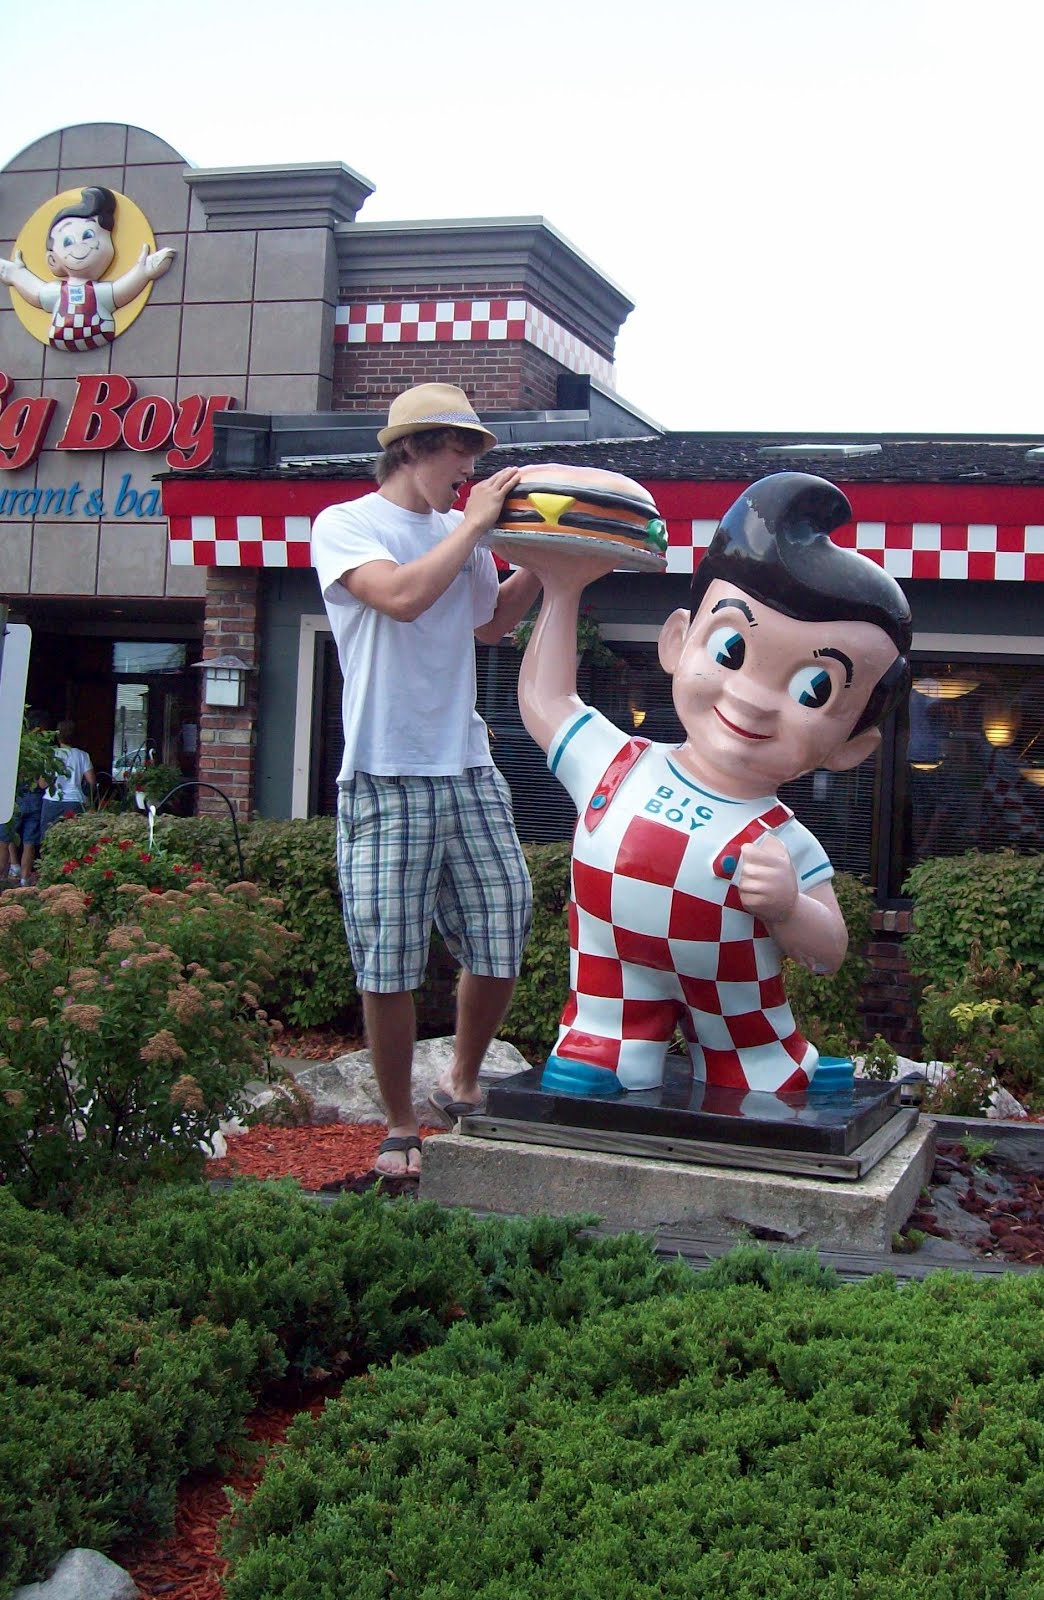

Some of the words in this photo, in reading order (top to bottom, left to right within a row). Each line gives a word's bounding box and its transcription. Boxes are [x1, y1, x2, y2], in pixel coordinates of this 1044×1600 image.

[0, 371, 57, 470] g
[56, 374, 236, 470] Boy
[83, 487, 105, 516] &
[114, 472, 162, 517] ba
[644, 798, 706, 830] BOY
[656, 785, 714, 820] BIG
